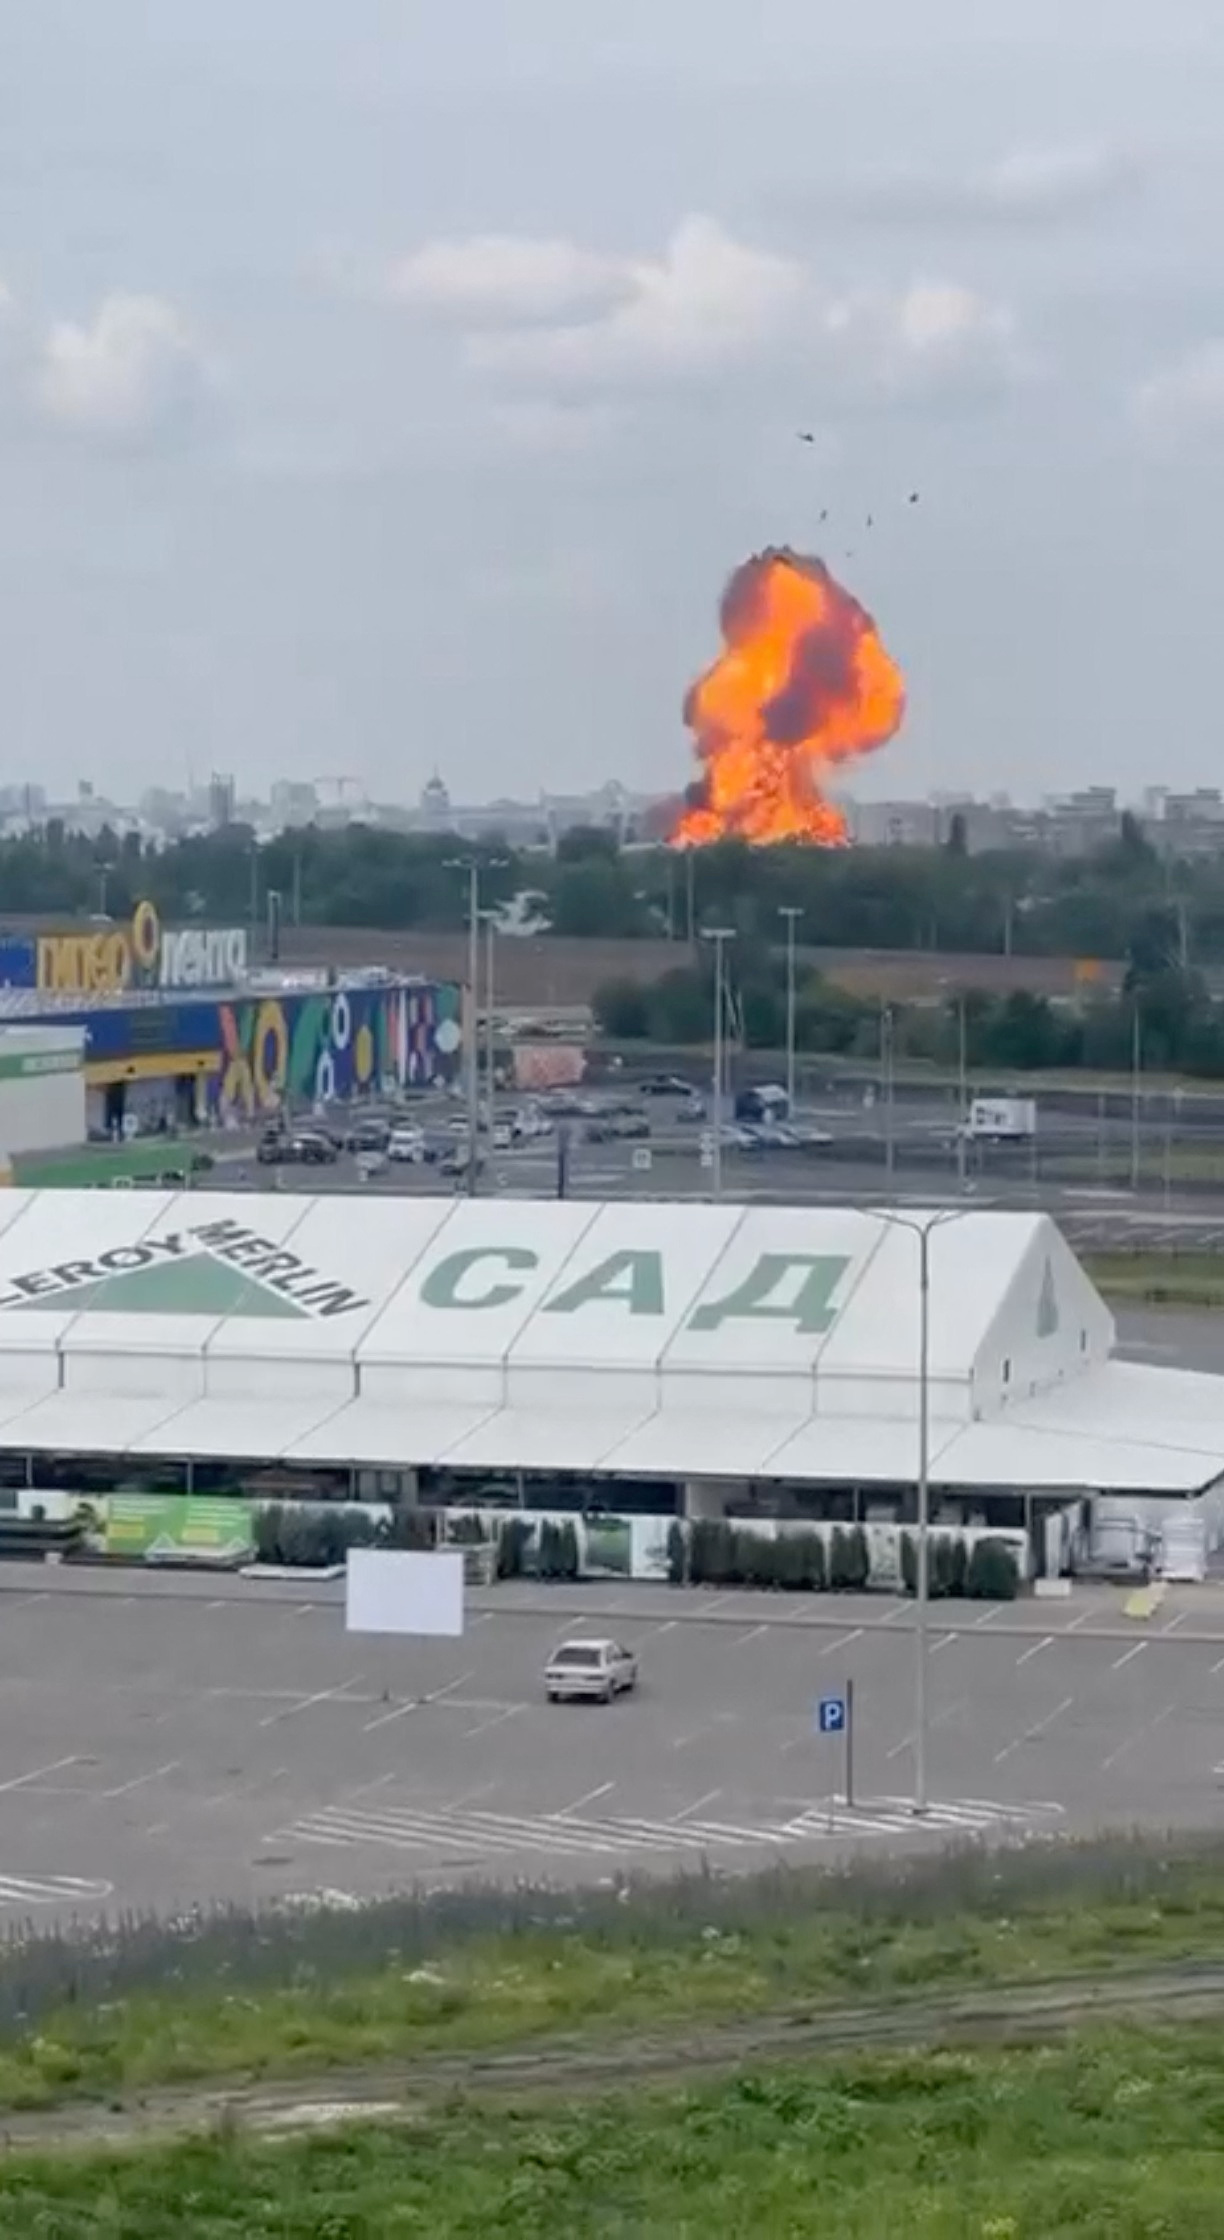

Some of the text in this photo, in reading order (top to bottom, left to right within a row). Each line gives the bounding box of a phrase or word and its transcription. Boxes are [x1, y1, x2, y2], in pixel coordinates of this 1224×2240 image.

[187, 1219, 371, 1316] MERLIN
[419, 1246, 852, 1333] САД
[825, 1702, 841, 1729] P
